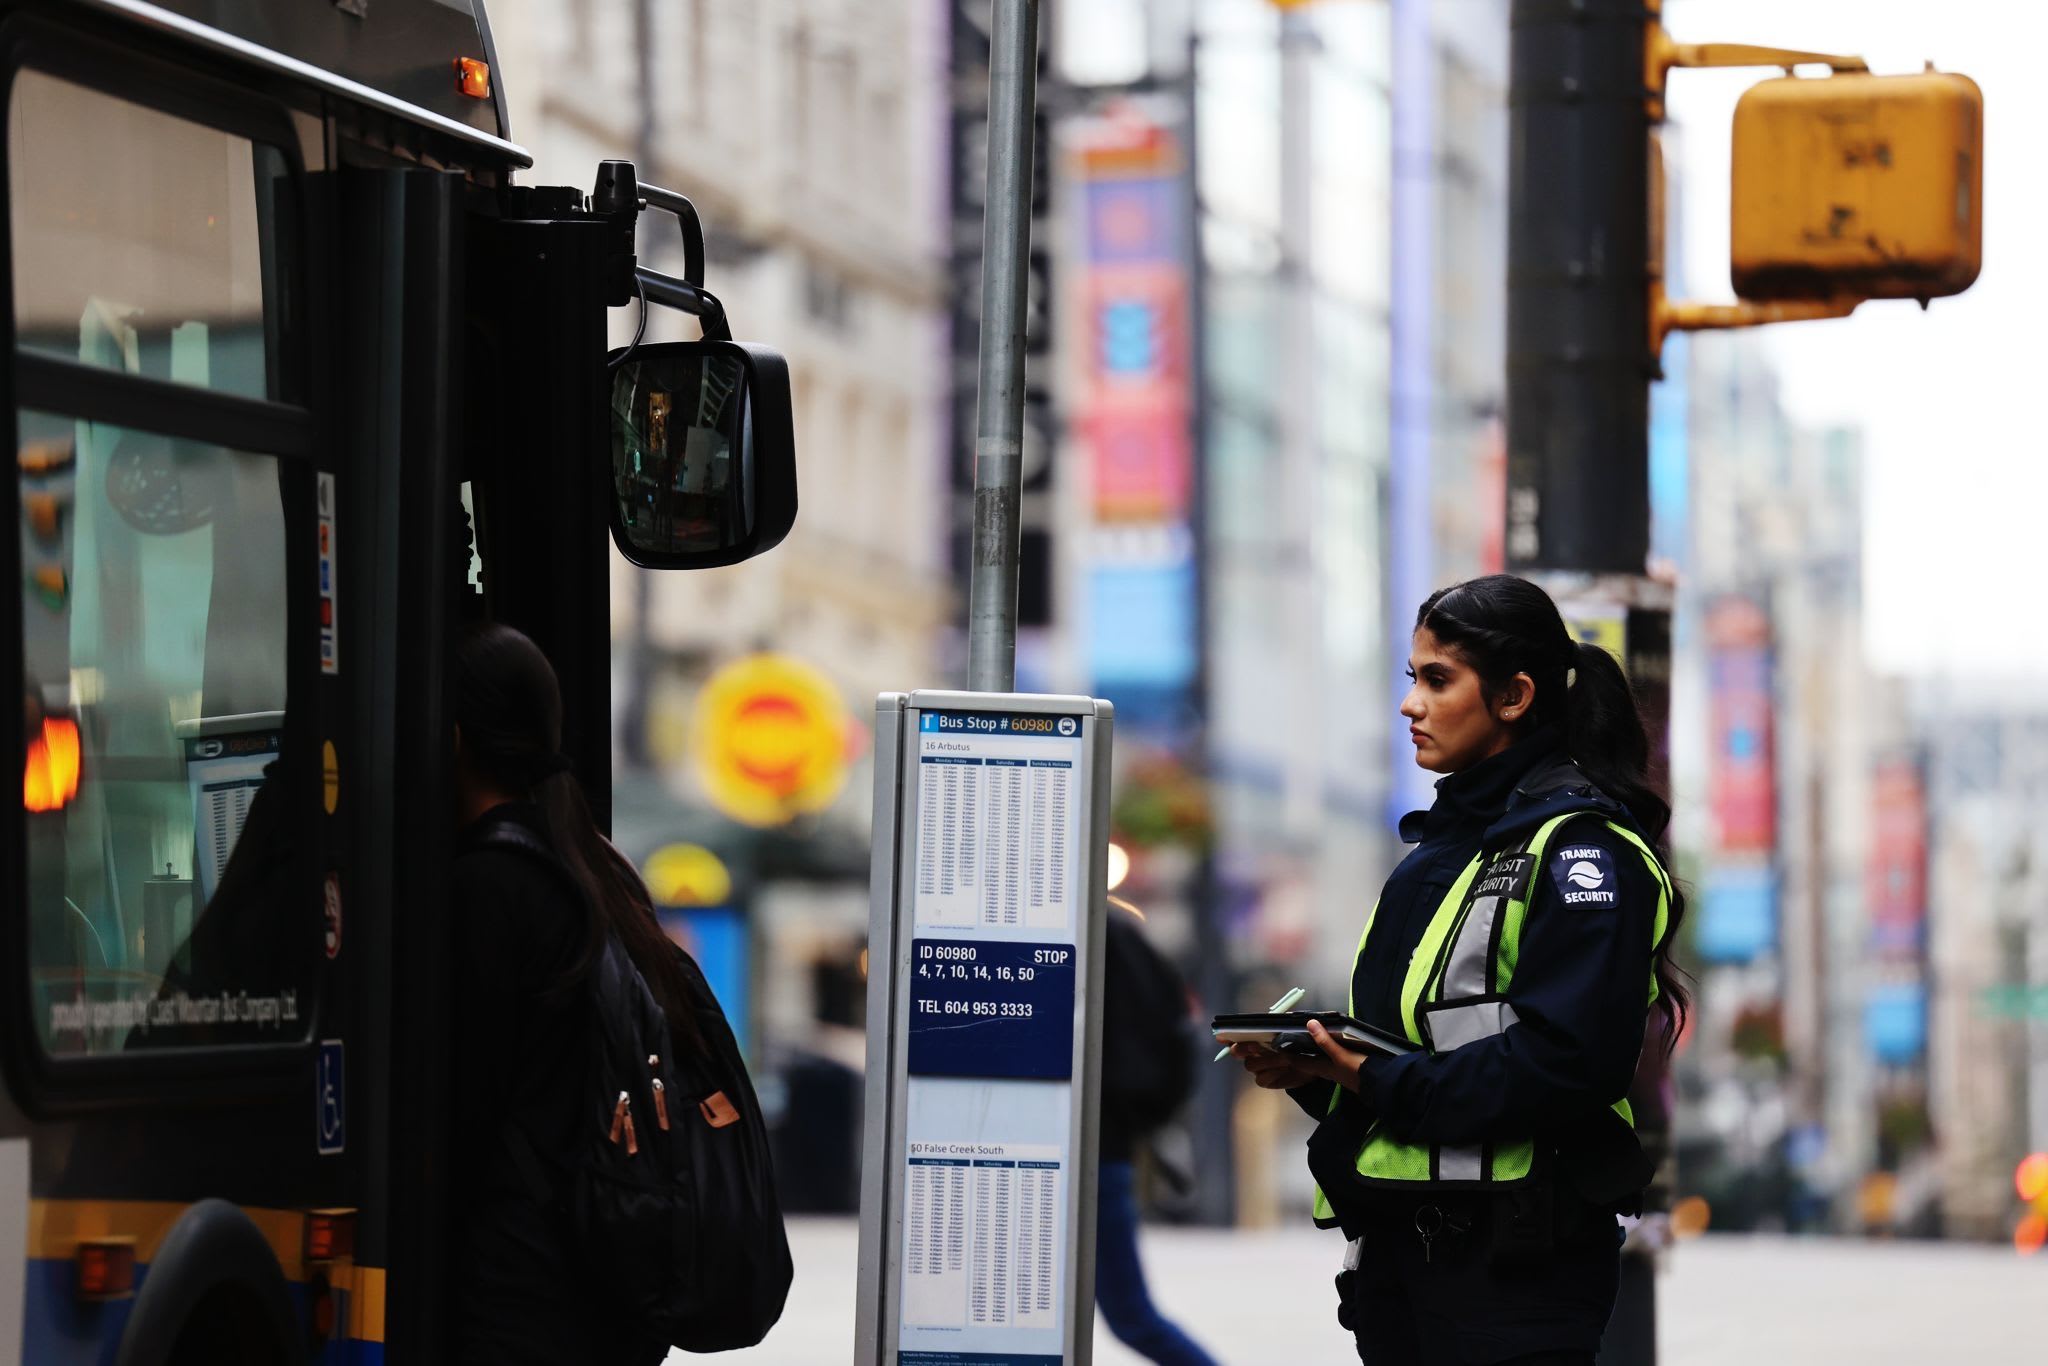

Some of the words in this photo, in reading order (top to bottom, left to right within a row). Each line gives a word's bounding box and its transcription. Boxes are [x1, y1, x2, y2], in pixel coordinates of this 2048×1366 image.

[939, 715, 964, 729] Bus
[967, 716, 997, 732] Stop
[1000, 718, 1009, 730] #
[1011, 718, 1054, 732] 60980
[925, 741, 936, 750] 16
[938, 742, 971, 752] Arbutus
[1559, 848, 1601, 861] TRANSIT
[1485, 859, 1526, 879] ANSIT
[1474, 877, 1519, 895] CURITY
[1564, 891, 1614, 904] SECURITY
[919, 945, 933, 959] ID
[935, 946, 977, 961] 60980
[1033, 949, 1069, 964] STOP
[919, 964, 931, 979] 4,
[935, 964, 946, 979] 7,
[950, 964, 969, 980] 10,
[973, 965, 992, 981] 14,
[996, 966, 1015, 982] 16,
[1018, 967, 1035, 981] 50
[222, 990, 238, 1022] Bus
[240, 989, 279, 1029] Company
[918, 999, 942, 1014] TEL
[944, 1001, 970, 1015] 604
[972, 1001, 997, 1016] 953
[1000, 1002, 1033, 1017] 3333
[911, 1143, 923, 1153] 50
[924, 1143, 947, 1153] False
[949, 1144, 976, 1154] Creek
[977, 1145, 1004, 1155] South
